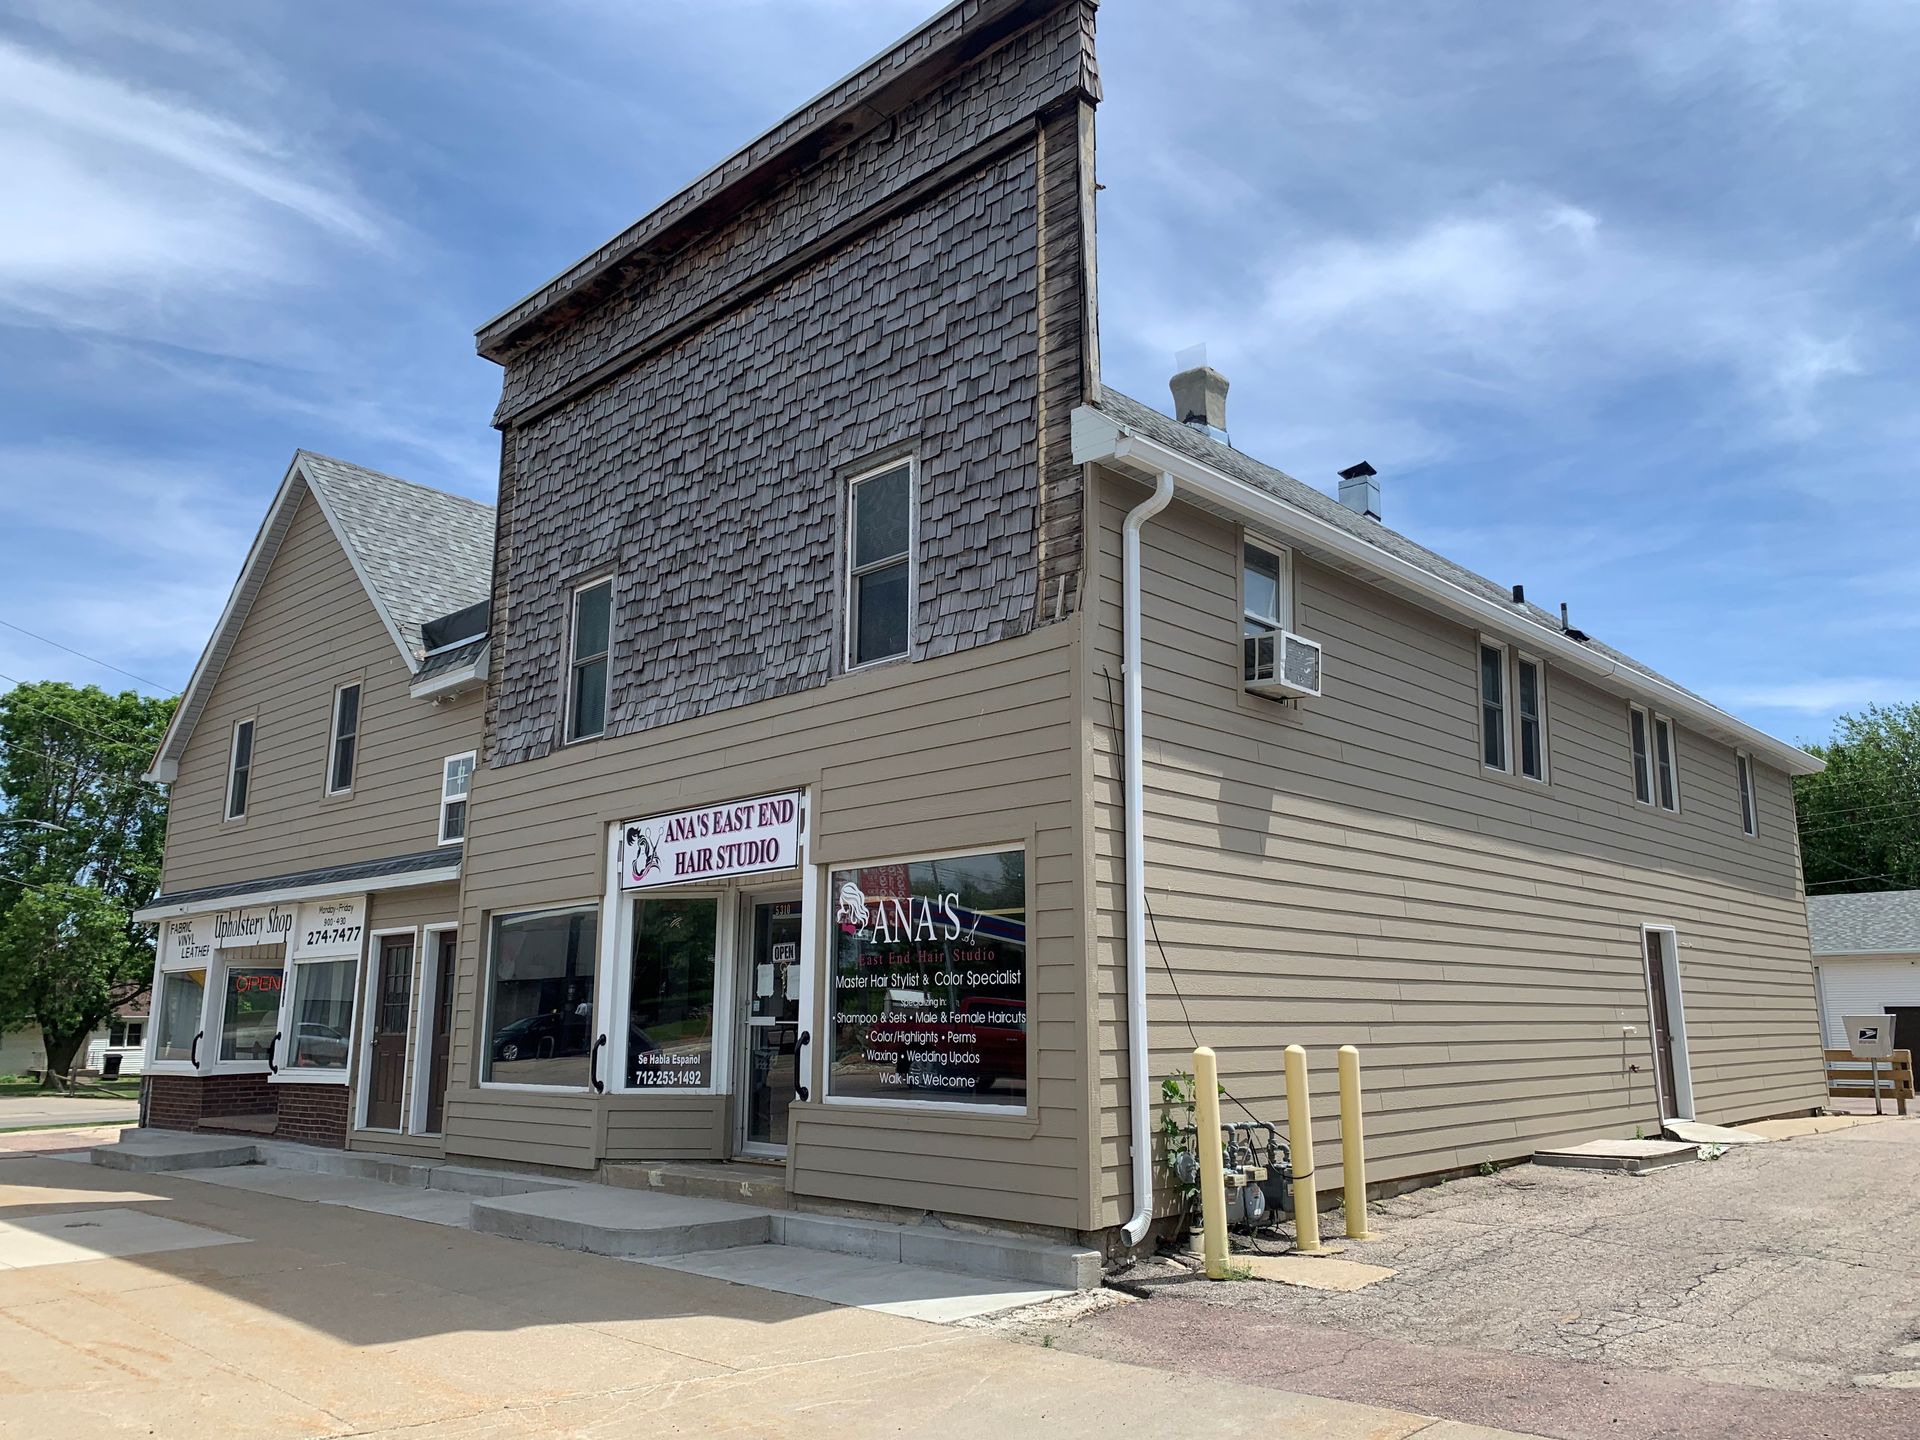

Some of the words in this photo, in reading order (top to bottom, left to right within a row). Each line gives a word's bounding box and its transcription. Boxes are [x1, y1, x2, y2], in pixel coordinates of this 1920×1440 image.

[664, 812, 709, 843] ANA'S
[712, 805, 754, 834] EAST
[757, 798, 794, 828] END
[674, 847, 713, 875] HAIR
[716, 837, 779, 870] STUDIO
[775, 904, 791, 916] 5310
[870, 892, 961, 944] ANA'S
[170, 921, 192, 934] FABRIC
[214, 909, 264, 949] Upholstery
[266, 905, 293, 943] Shop
[178, 933, 195, 946] VINYL
[774, 945, 794, 960] OPEN
[859, 956, 883, 966] East
[888, 952, 910, 964] End
[918, 951, 944, 963] Hair
[953, 948, 995, 961] Studio
[236, 975, 282, 992] OPEN
[835, 974, 868, 989] Master
[870, 973, 889, 988] Hair
[891, 971, 920, 989] Stylist
[922, 973, 930, 986] &
[934, 971, 964, 986] Color
[966, 969, 1021, 988] Specialist
[836, 1012, 877, 1027] Shampoo
[880, 1013, 888, 1024] &
[888, 1012, 907, 1024] Sets
[915, 1012, 938, 1024] Male
[940, 1012, 949, 1024] &
[949, 1012, 986, 1024] Female
[987, 1010, 1027, 1024] Haircuts
[870, 1030, 939, 1046] Color/Highlights
[947, 1032, 977, 1044] Perms
[638, 1054, 648, 1065] Se
[649, 1054, 671, 1065] Habla
[672, 1054, 701, 1067] Español
[866, 1051, 898, 1064] Waxing
[906, 1051, 948, 1066] Wedding
[949, 1051, 981, 1065] Updos
[636, 1071, 701, 1084] 712-253-1492
[879, 1072, 920, 1086] Walk-Ins
[922, 1074, 976, 1088] Welcome
